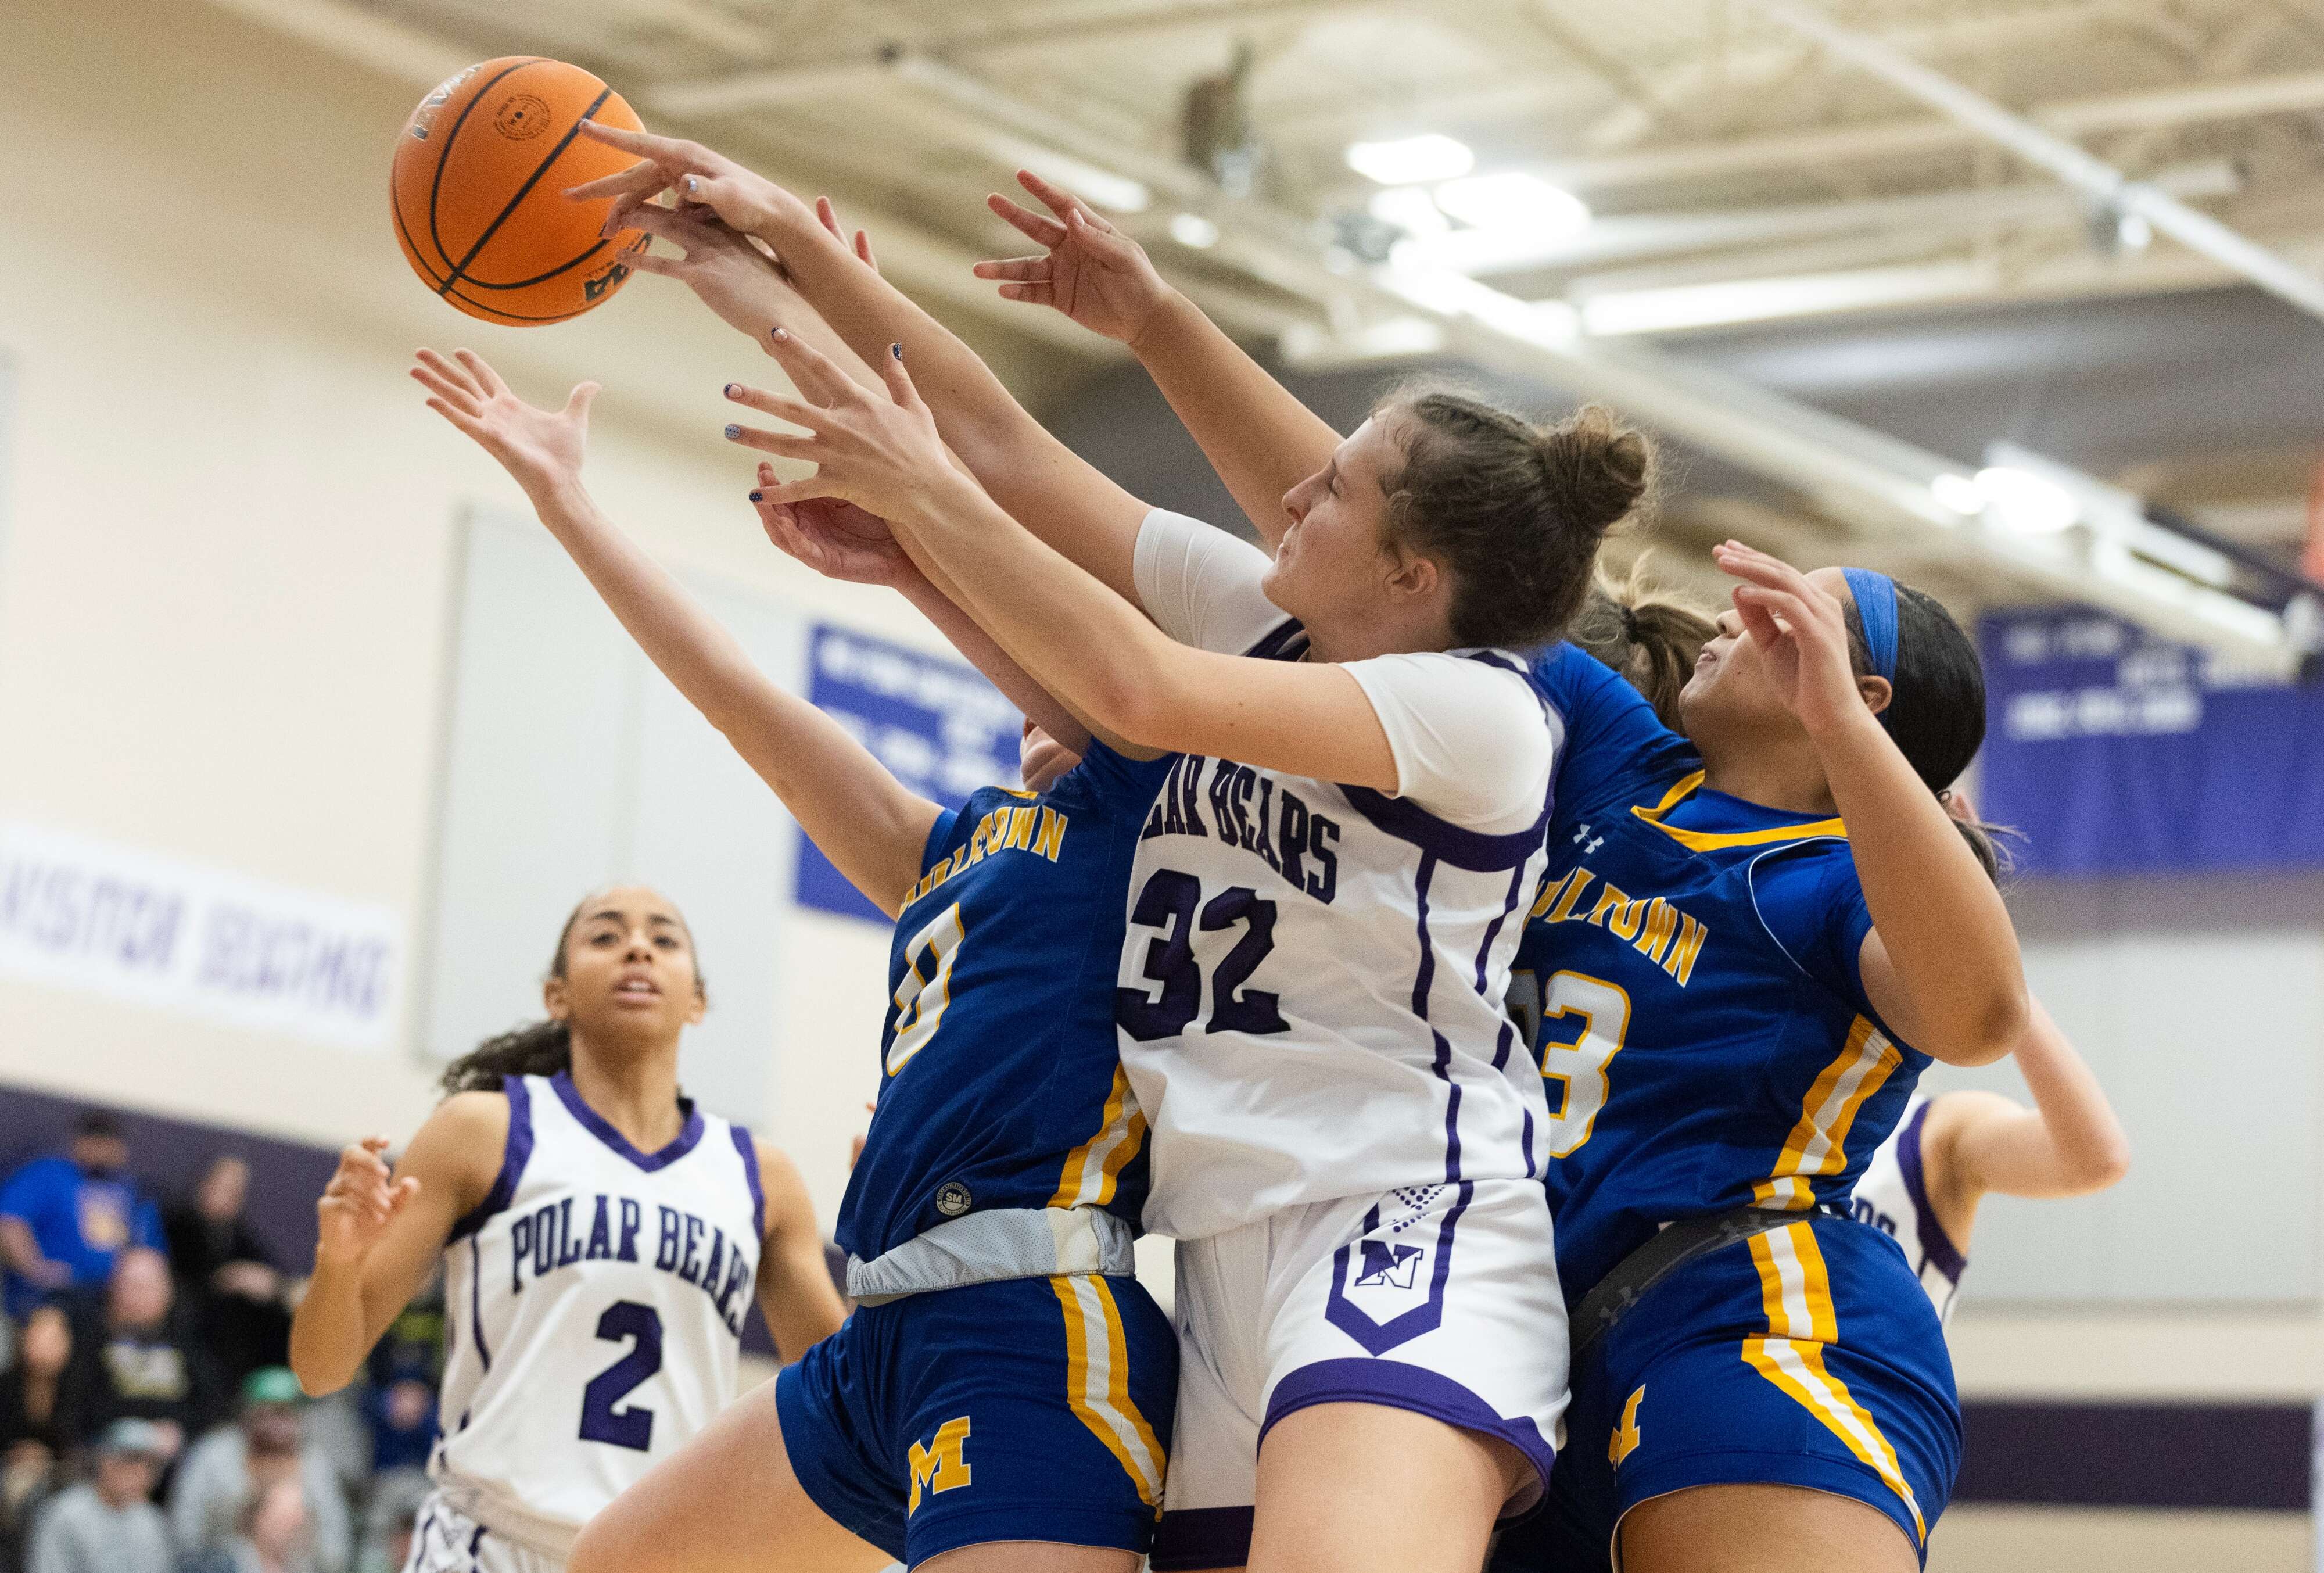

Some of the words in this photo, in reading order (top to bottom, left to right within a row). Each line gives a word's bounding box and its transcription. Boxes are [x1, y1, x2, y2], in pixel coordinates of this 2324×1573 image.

[1208, 757, 1340, 905] BEARS
[1116, 868, 1292, 1042] 32
[1504, 969, 1631, 1158] 3
[511, 1194, 640, 1295] POLAR
[945, 1192, 962, 1203] SM
[1354, 1239, 1423, 1289] N
[579, 1299, 663, 1452] 2
[908, 1416, 971, 1520] M
